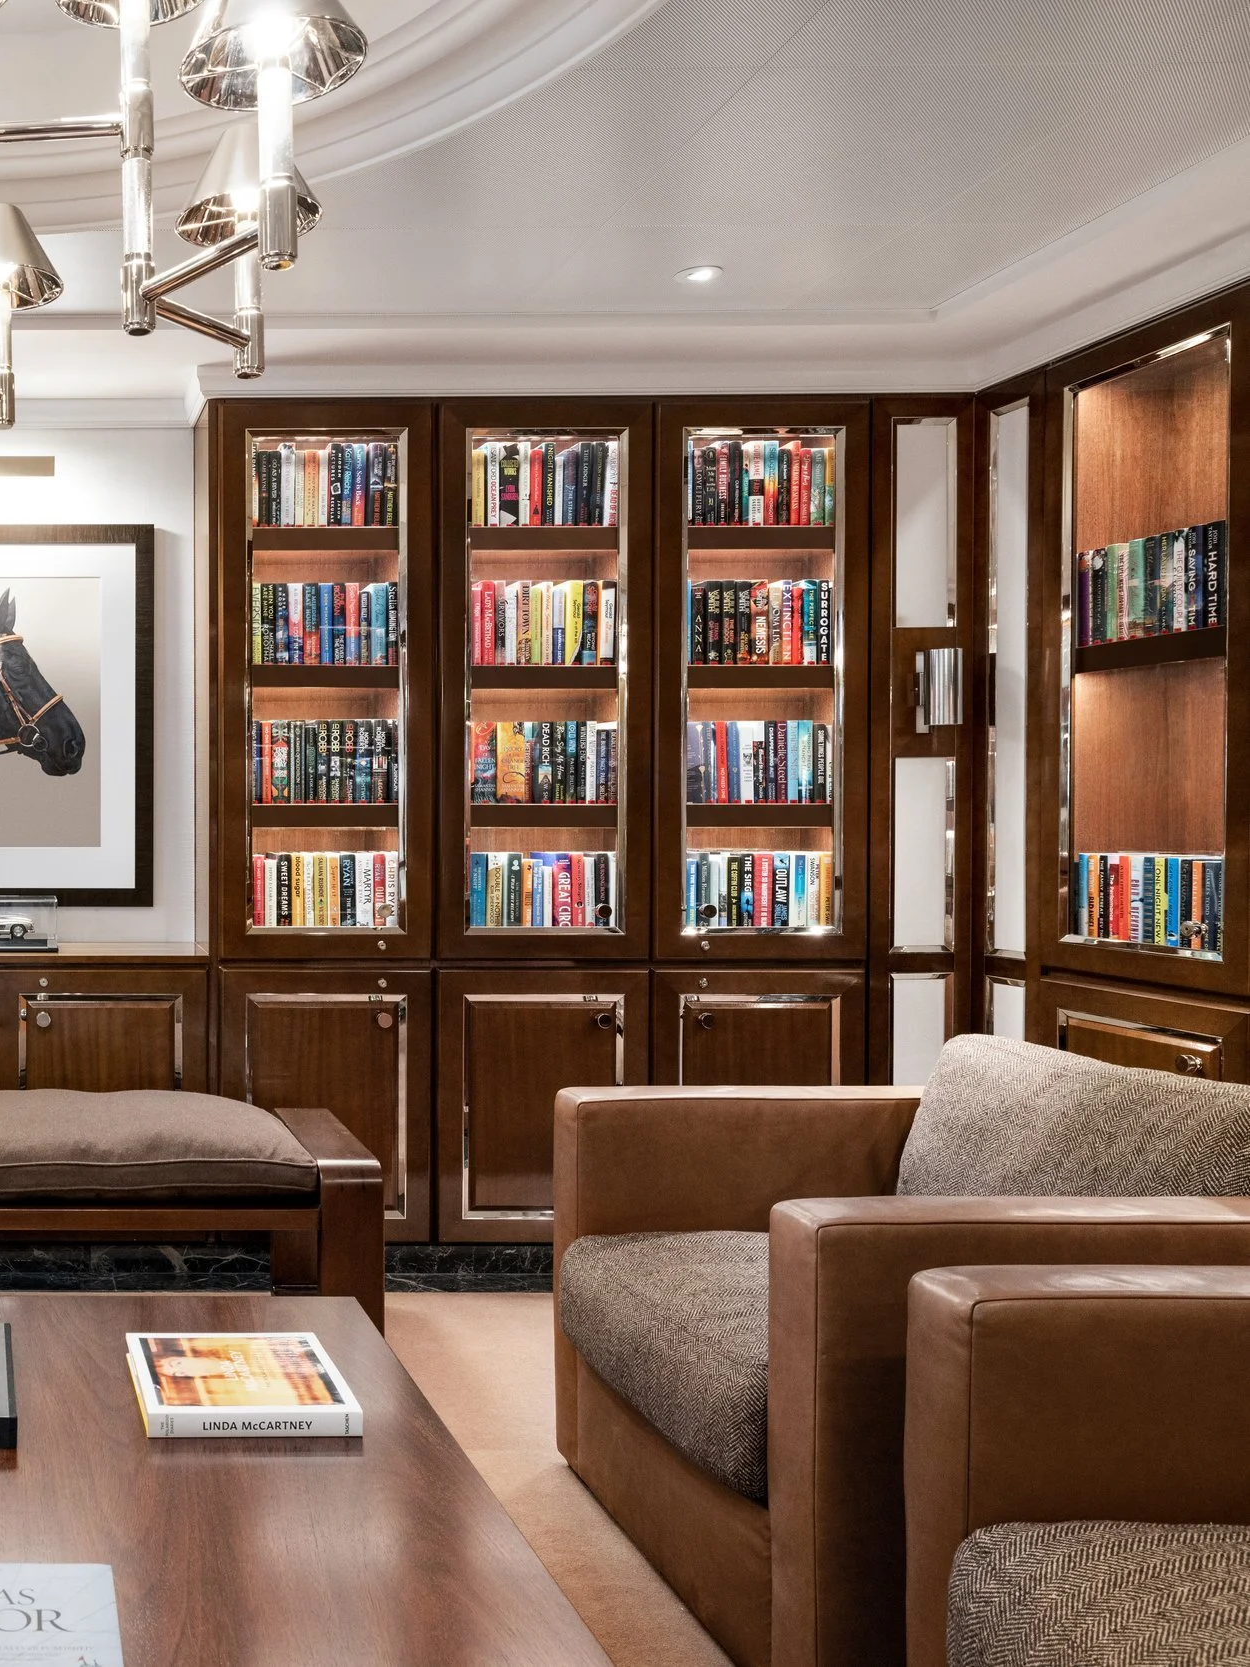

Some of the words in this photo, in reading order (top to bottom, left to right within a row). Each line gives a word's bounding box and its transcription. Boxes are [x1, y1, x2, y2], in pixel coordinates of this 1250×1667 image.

[343, 448, 353, 470] Kathy
[753, 445, 761, 477] CODENAME
[344, 471, 352, 495] Reichs
[719, 475, 727, 500] BUSINESS
[753, 480, 761, 495] FAUST
[1176, 565, 1184, 591] GUILTY
[1188, 549, 1196, 591] SAVING
[1207, 551, 1217, 591] HARD
[522, 585, 530, 606] DIRT
[1176, 593, 1184, 625] COUPLE
[1208, 593, 1218, 624] TIME
[389, 610, 397, 642] RIMINGTON
[522, 609, 530, 635] TOWN
[819, 583, 828, 662] SURROGATE
[755, 616, 766, 654] NEMESIS
[318, 729, 327, 753] ROBB
[331, 729, 340, 753] ROBB
[345, 729, 354, 753] ROBB
[542, 723, 550, 746] DEAD
[777, 723, 787, 760] Danielle
[817, 730, 825, 758] SOMETIMES
[542, 747, 550, 766] RICH
[817, 758, 825, 775] PEOPLE
[720, 767, 725, 776] NO
[777, 760, 787, 784] Steel
[817, 775, 825, 784] DIE
[343, 859, 351, 886] RYAN
[744, 855, 752, 872] THE
[363, 868, 372, 905] MARTYR
[558, 871, 571, 903] GREAT
[744, 873, 752, 897] SIEGE
[775, 869, 787, 903] OUTLAW
[202, 1421, 238, 1431] LINDA
[241, 1420, 313, 1431] McCARTNEY
